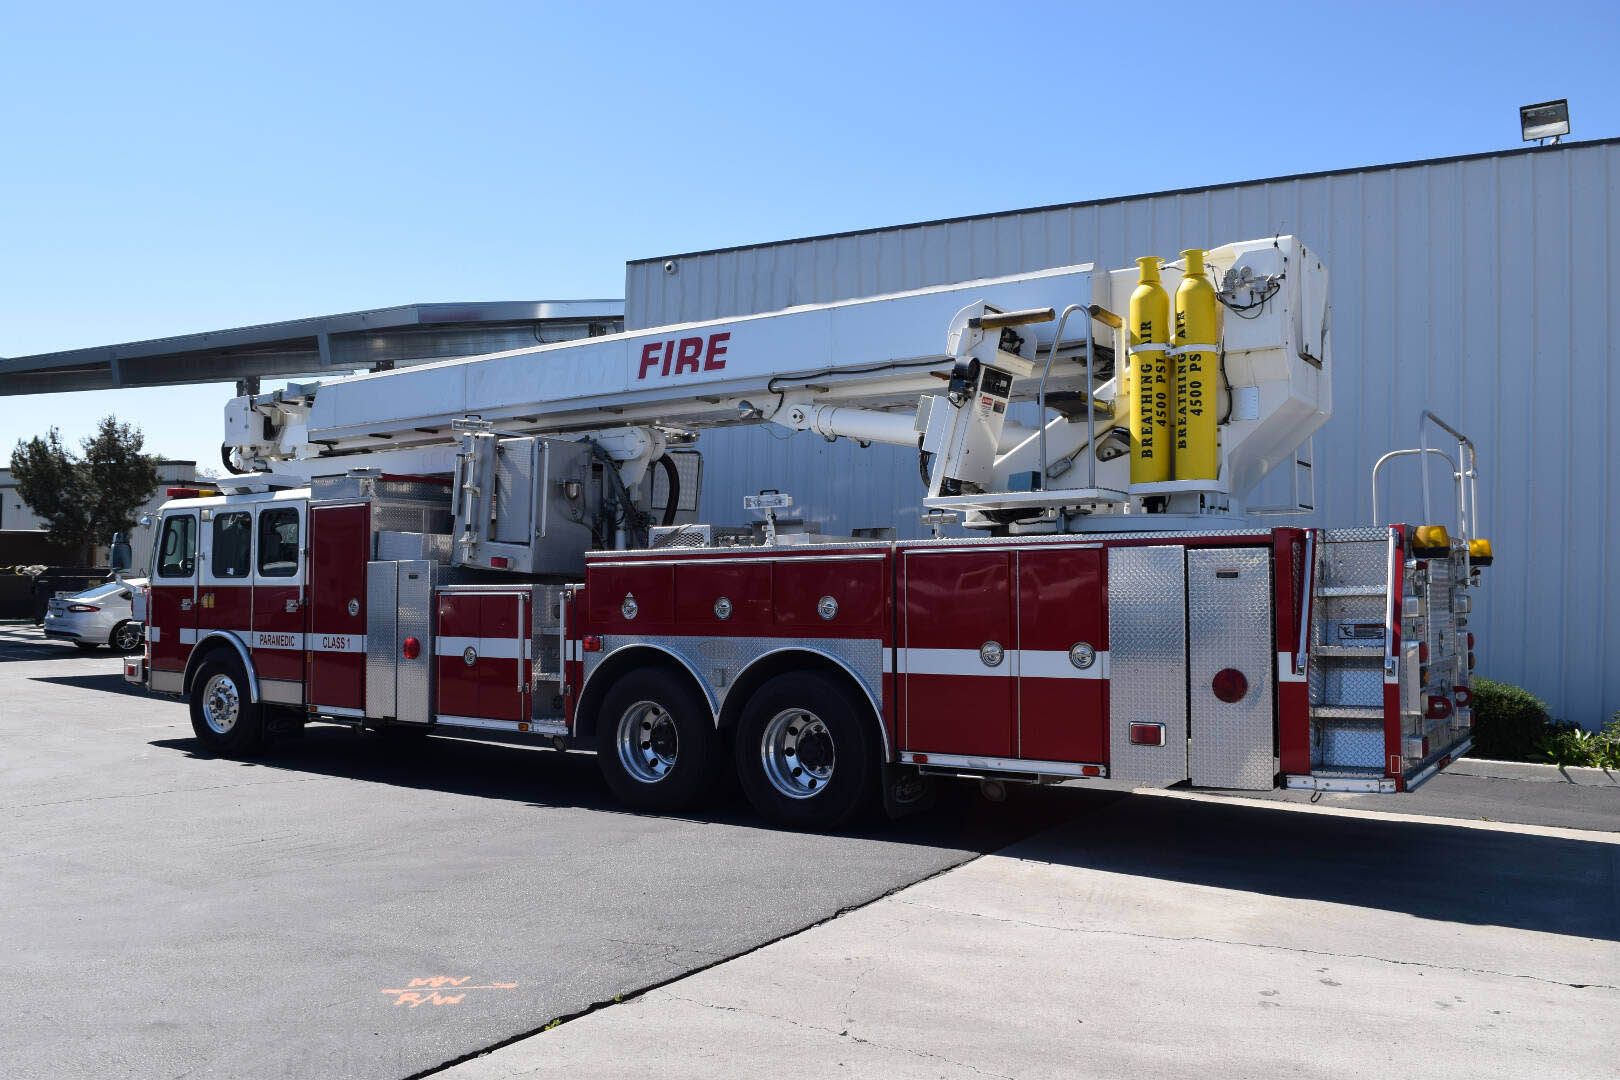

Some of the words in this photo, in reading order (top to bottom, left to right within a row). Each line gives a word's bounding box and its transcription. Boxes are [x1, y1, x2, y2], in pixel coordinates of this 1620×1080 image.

[1177, 310, 1186, 339] AIR
[638, 332, 731, 379] FIRE
[1156, 358, 1166, 384] PSI
[1141, 363, 1153, 459] BREATHING
[1156, 392, 1167, 427] 4500
[1177, 353, 1187, 449] BREATHING
[1189, 381, 1203, 416] 4500
[260, 634, 295, 648] PARAMEDIC
[323, 637, 345, 649] CLASS
[346, 638, 351, 649] 1
